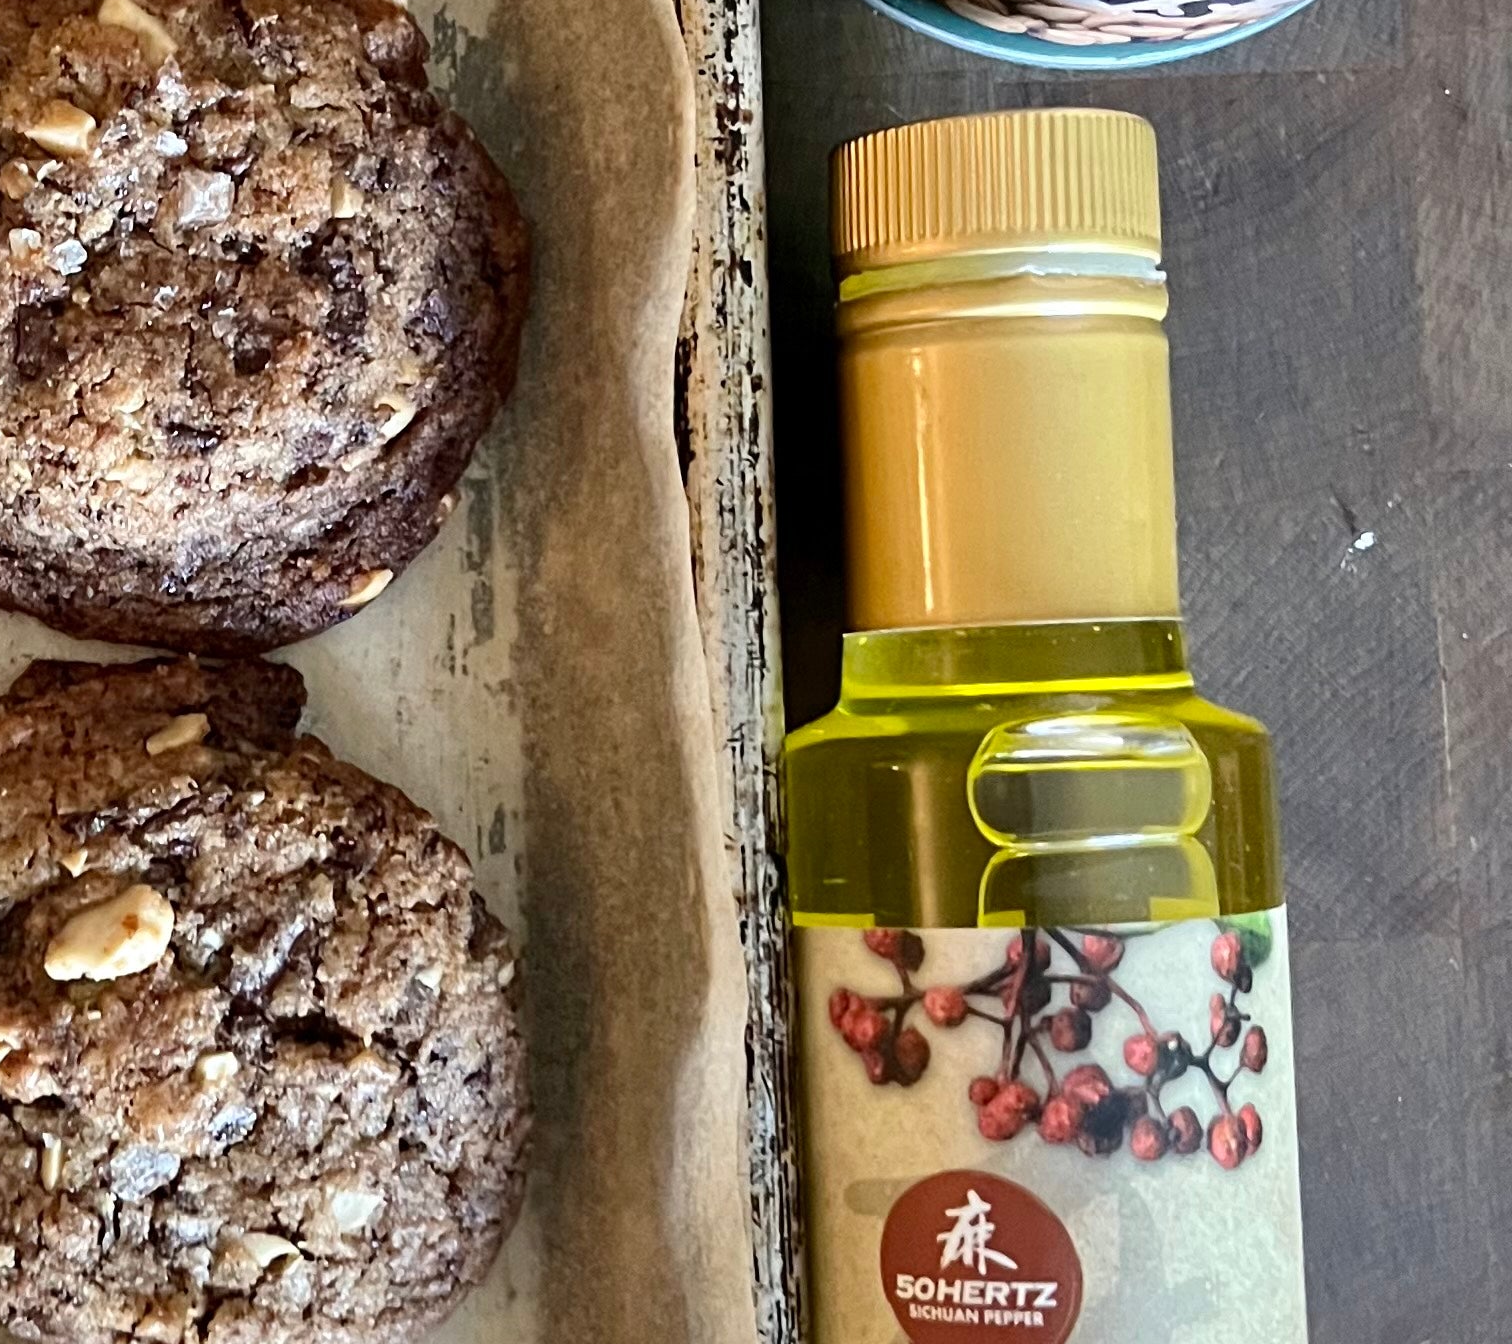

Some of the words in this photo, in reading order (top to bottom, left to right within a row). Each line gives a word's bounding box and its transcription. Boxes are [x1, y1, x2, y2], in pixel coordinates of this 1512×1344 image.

[896, 1273, 1058, 1307] 50HERTZ
[909, 1303, 979, 1325] SICHUAN
[984, 1309, 1044, 1327] PEPPER
